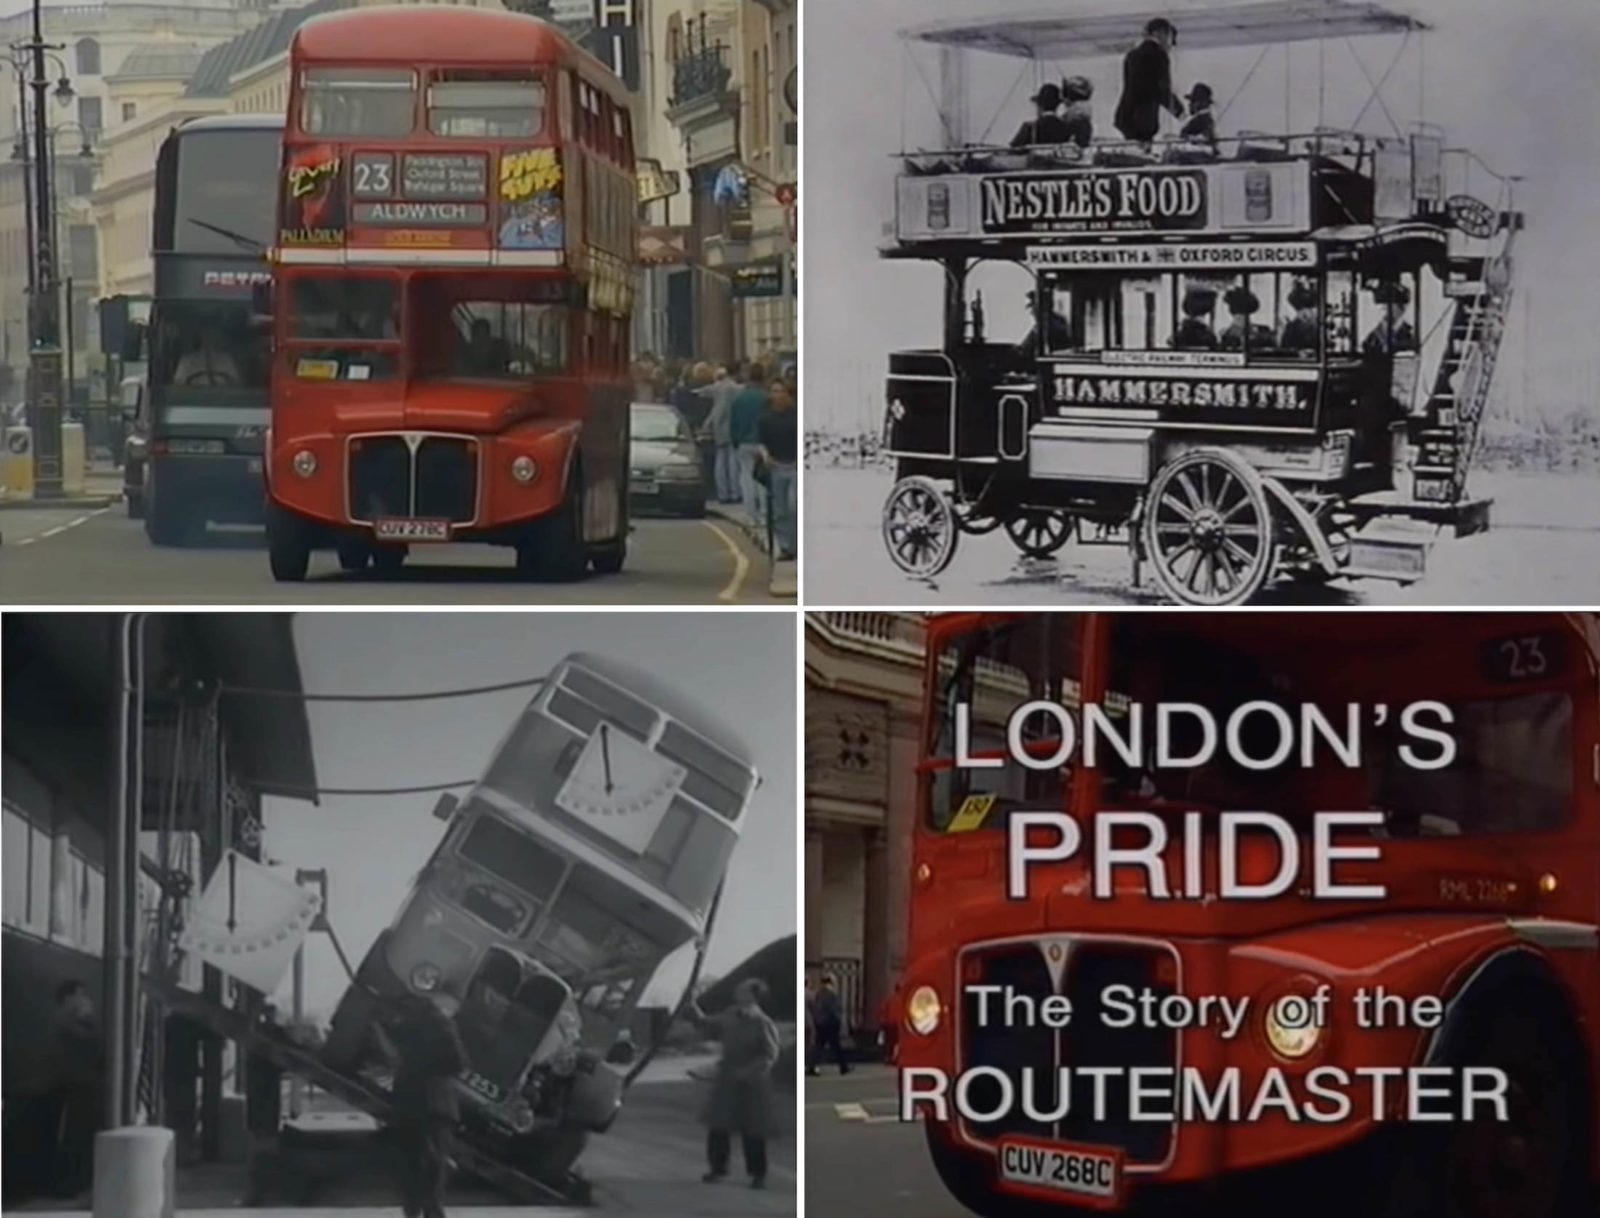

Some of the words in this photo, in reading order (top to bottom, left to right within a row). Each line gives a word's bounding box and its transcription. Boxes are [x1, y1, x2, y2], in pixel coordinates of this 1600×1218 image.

[354, 163, 390, 191] 23
[1117, 173, 1200, 216] FOOD
[372, 203, 466, 219] ALDWYCH
[1030, 250, 1139, 263] HAMMERSMITH
[1179, 248, 1244, 263] OXFORD
[1500, 637, 1547, 676] 23
[1440, 879, 1472, 901] RML
[1005, 1145, 1045, 1177] CUV
[1051, 1152, 1111, 1188] 268C
